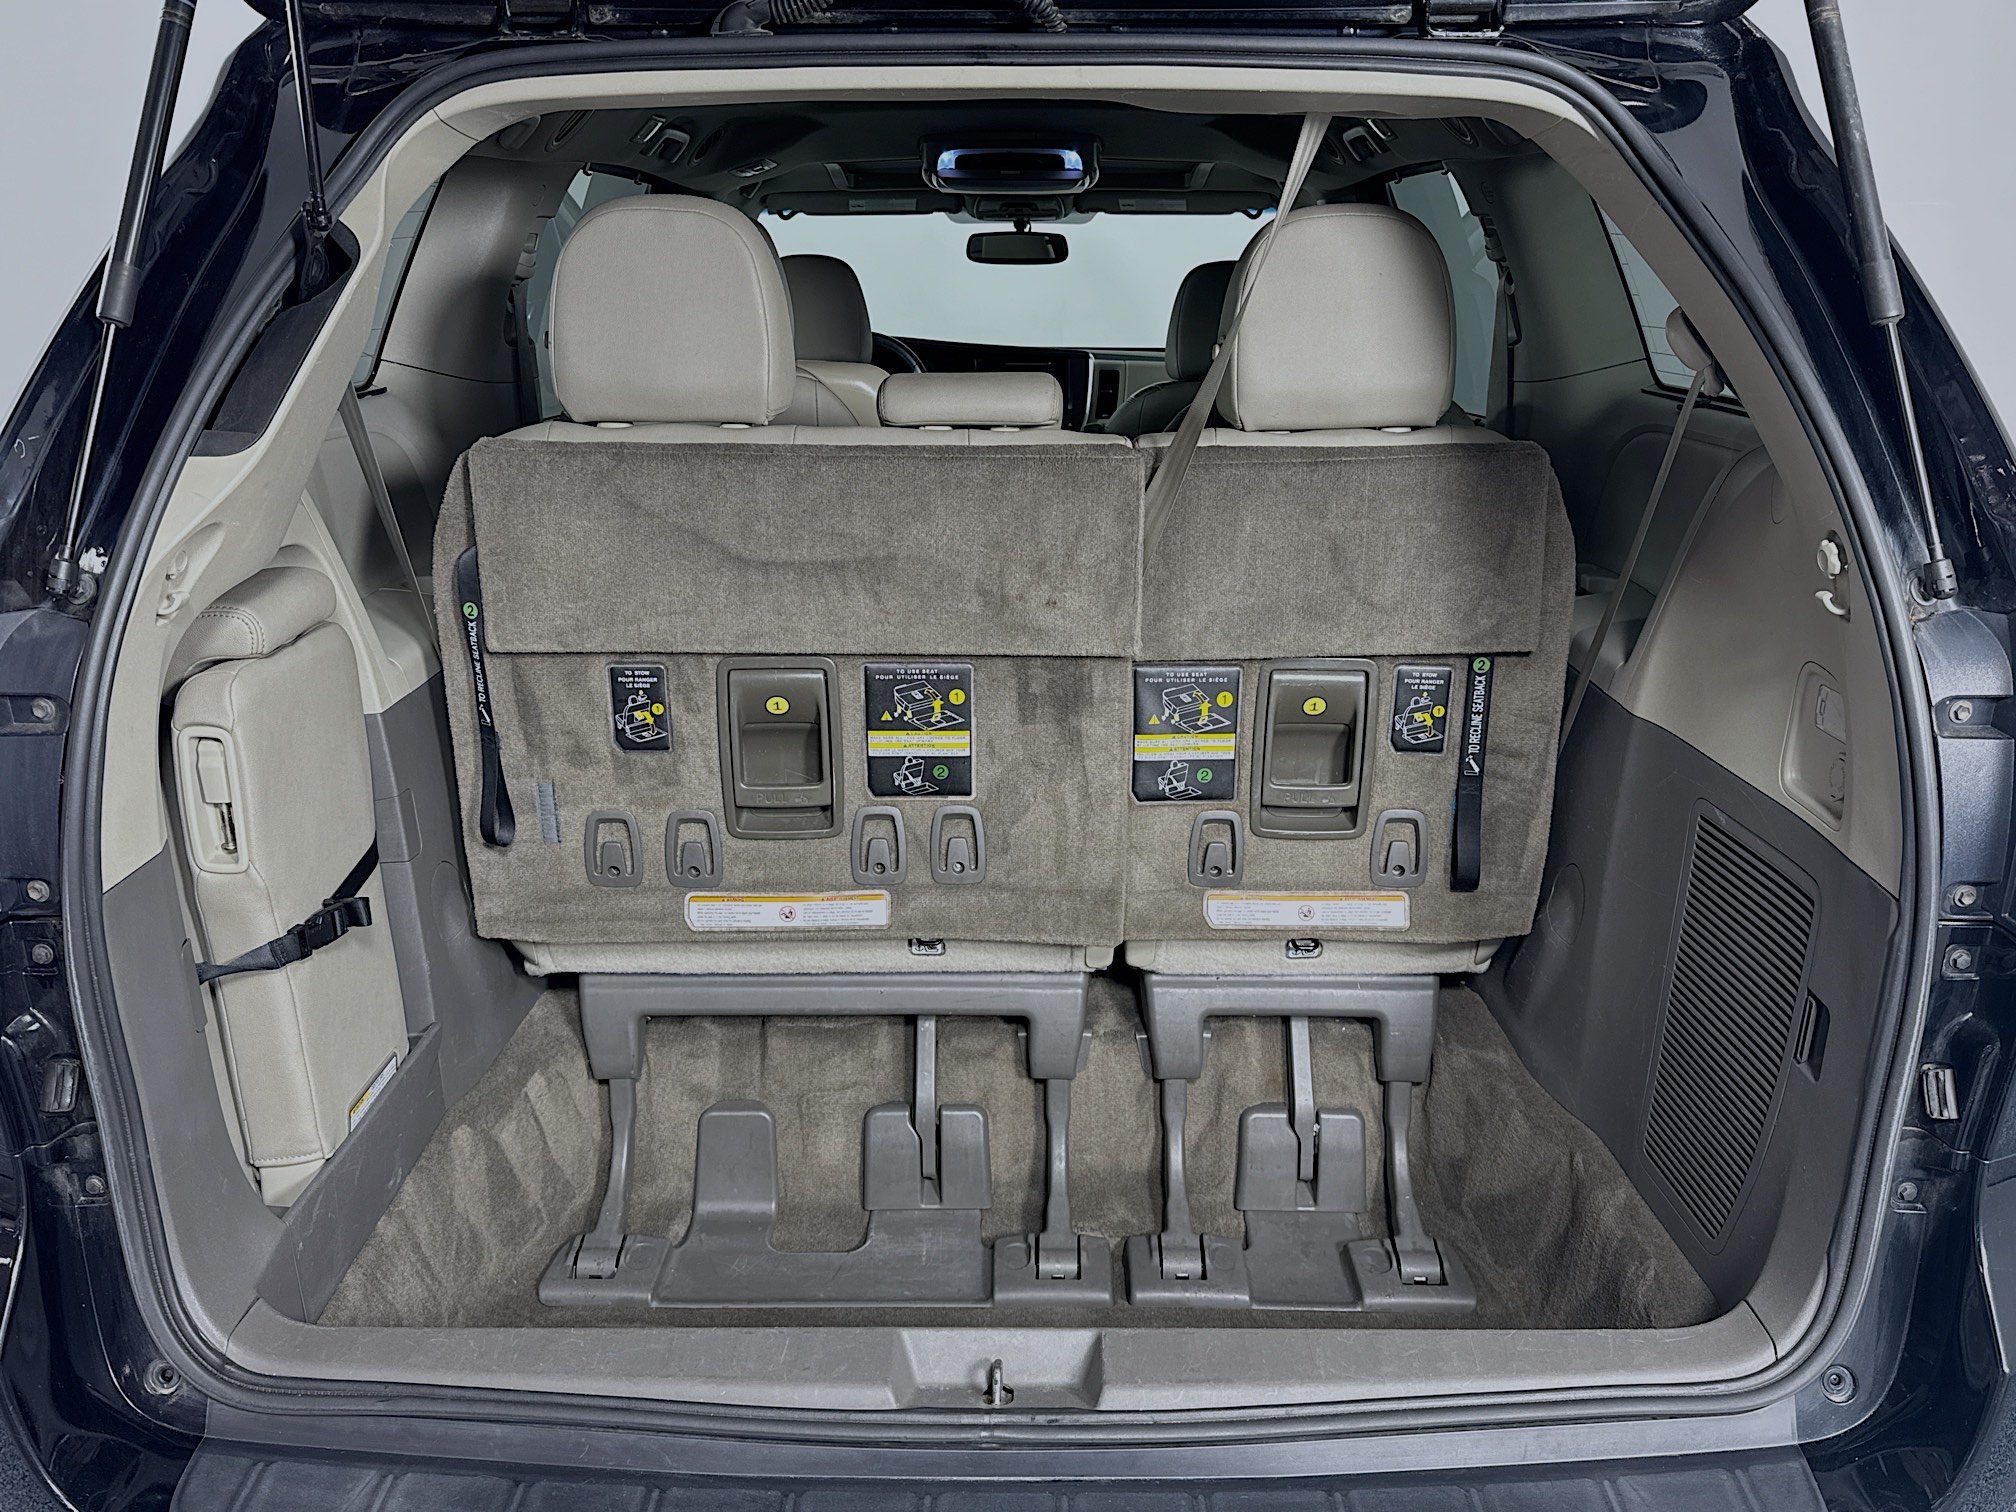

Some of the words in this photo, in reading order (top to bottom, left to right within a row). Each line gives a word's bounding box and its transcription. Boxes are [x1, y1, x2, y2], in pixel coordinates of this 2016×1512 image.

[467, 605, 474, 616] 2
[467, 621, 480, 660] SEATBACK
[1477, 660, 1486, 670] 2
[473, 660, 485, 693] RECLINE
[478, 692, 487, 703] TO
[1471, 674, 1487, 713] SEATBACK
[773, 702, 782, 710] 1
[1310, 702, 1318, 711] 1
[1468, 713, 1483, 744] RECLINE
[1467, 744, 1480, 754] TO
[936, 767, 945, 777] 2
[1200, 770, 1209, 781] 2
[756, 792, 787, 804] PULL
[1284, 792, 1315, 804] PULL
